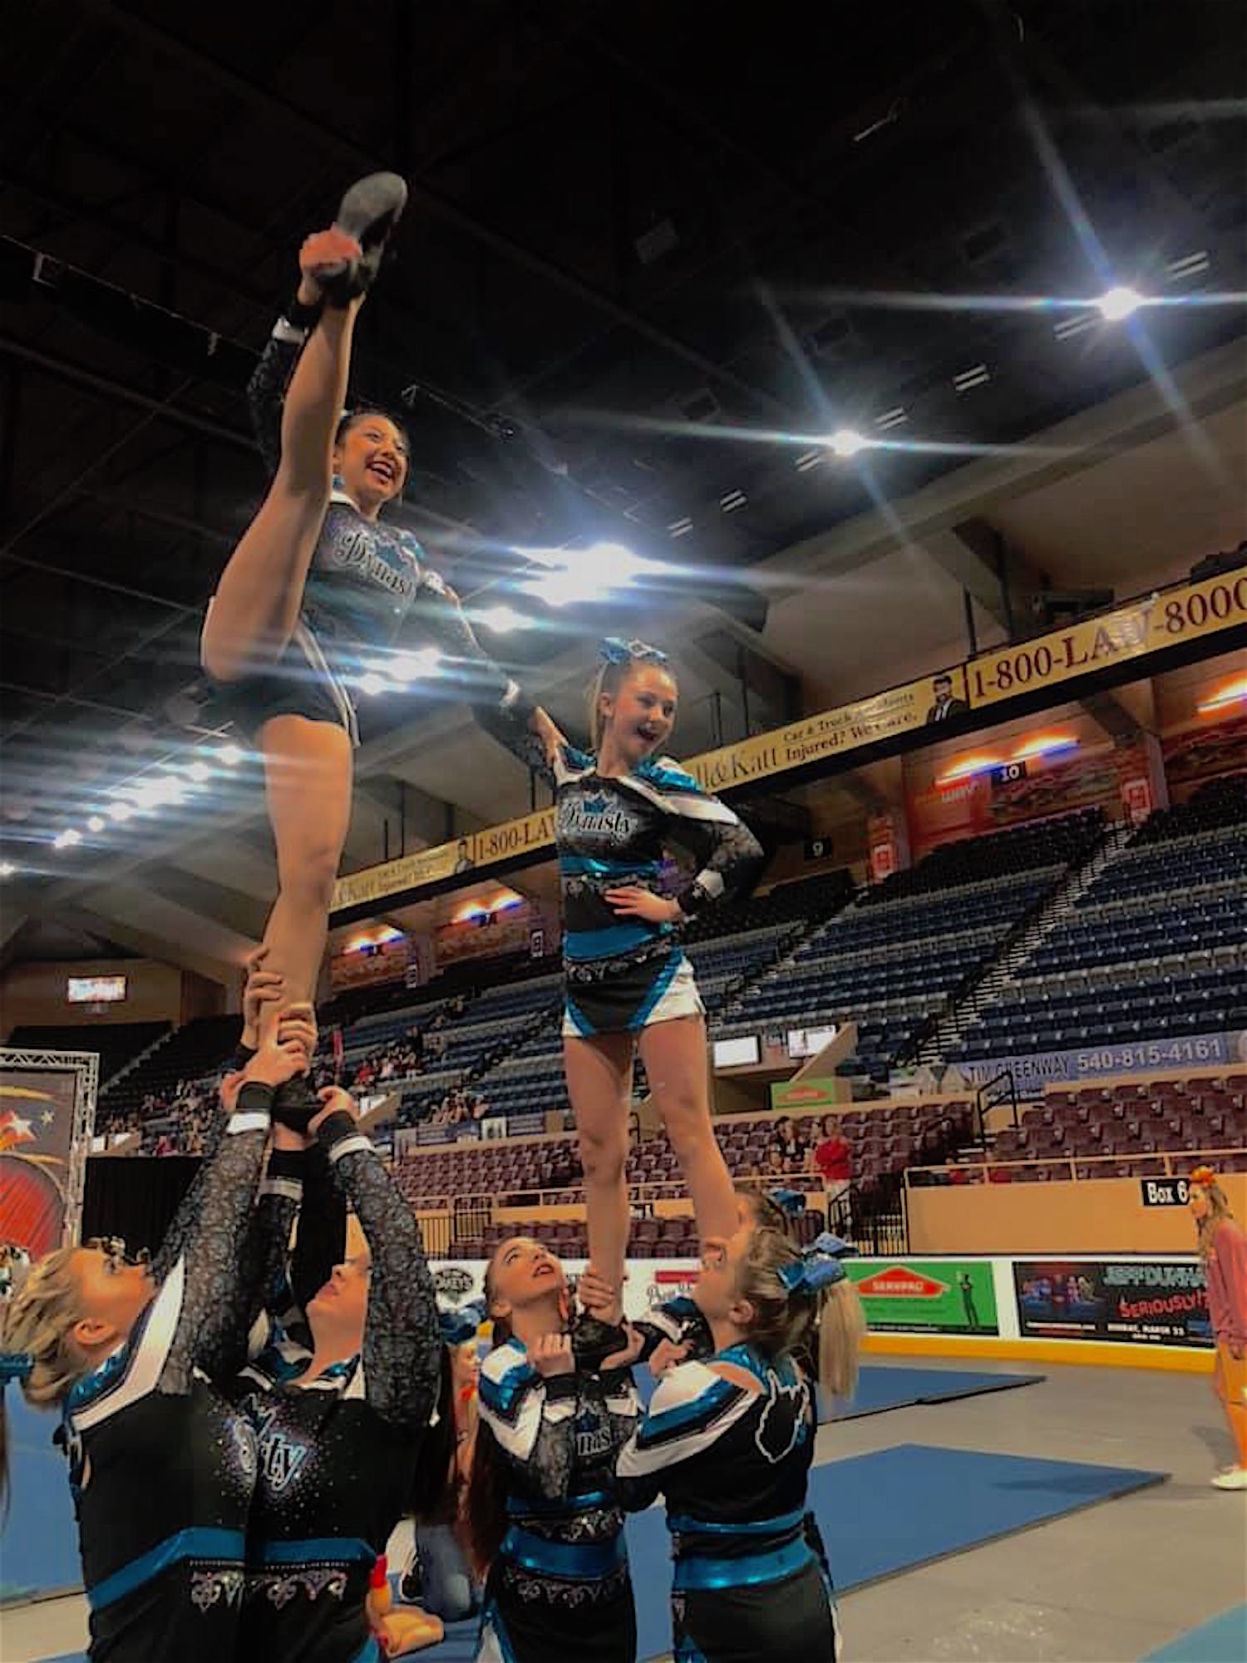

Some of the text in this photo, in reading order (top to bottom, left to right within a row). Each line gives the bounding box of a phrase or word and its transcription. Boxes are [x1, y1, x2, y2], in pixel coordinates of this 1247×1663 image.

[332, 527, 417, 600] Dynast
[786, 730, 847, 761] Injured?
[1002, 764, 1020, 782] 10
[812, 842, 824, 856] 9
[996, 1055, 1069, 1079] GREENWAY
[1077, 1038, 1221, 1073] 540-815-4161
[1146, 1179, 1188, 1204] Box 6
[872, 1280, 925, 1293] SERVPRO
